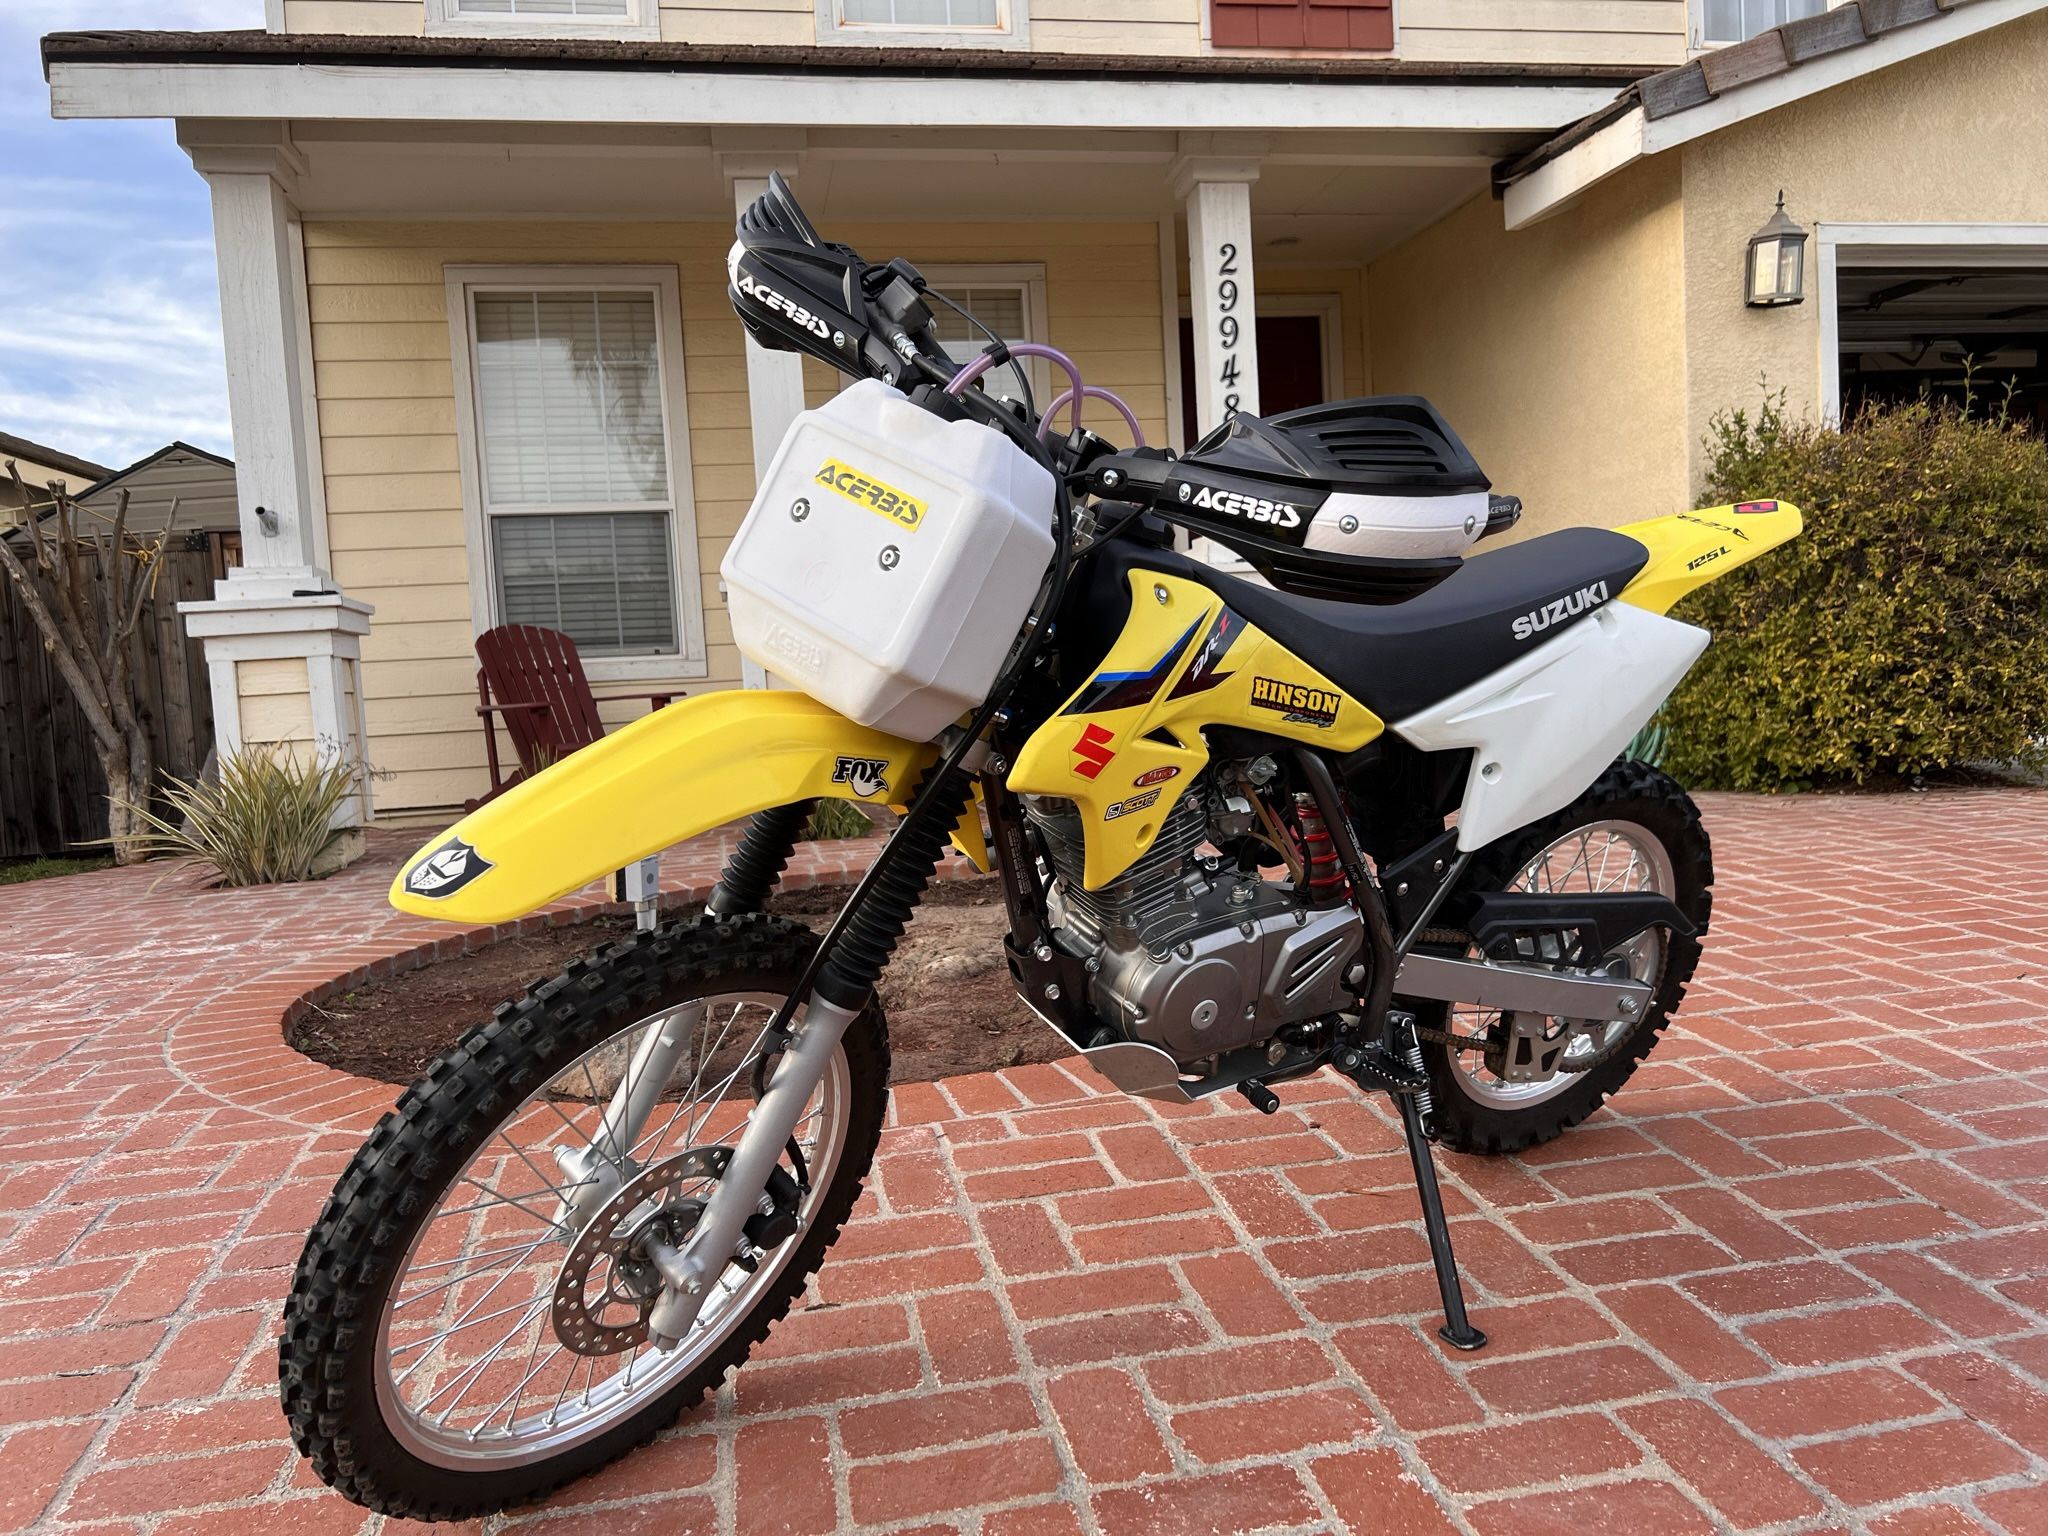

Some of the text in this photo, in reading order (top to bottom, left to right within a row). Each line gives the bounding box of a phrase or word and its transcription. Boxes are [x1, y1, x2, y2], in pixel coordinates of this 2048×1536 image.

[739, 276, 831, 339] ACERBIS
[1219, 243, 1241, 424] 29948
[815, 465, 919, 525] ACERBIS
[1192, 487, 1301, 529] ACERBIS
[1511, 580, 1609, 641] SUZUKI
[1253, 678, 1340, 714] HINSON
[833, 758, 889, 784] FOX
